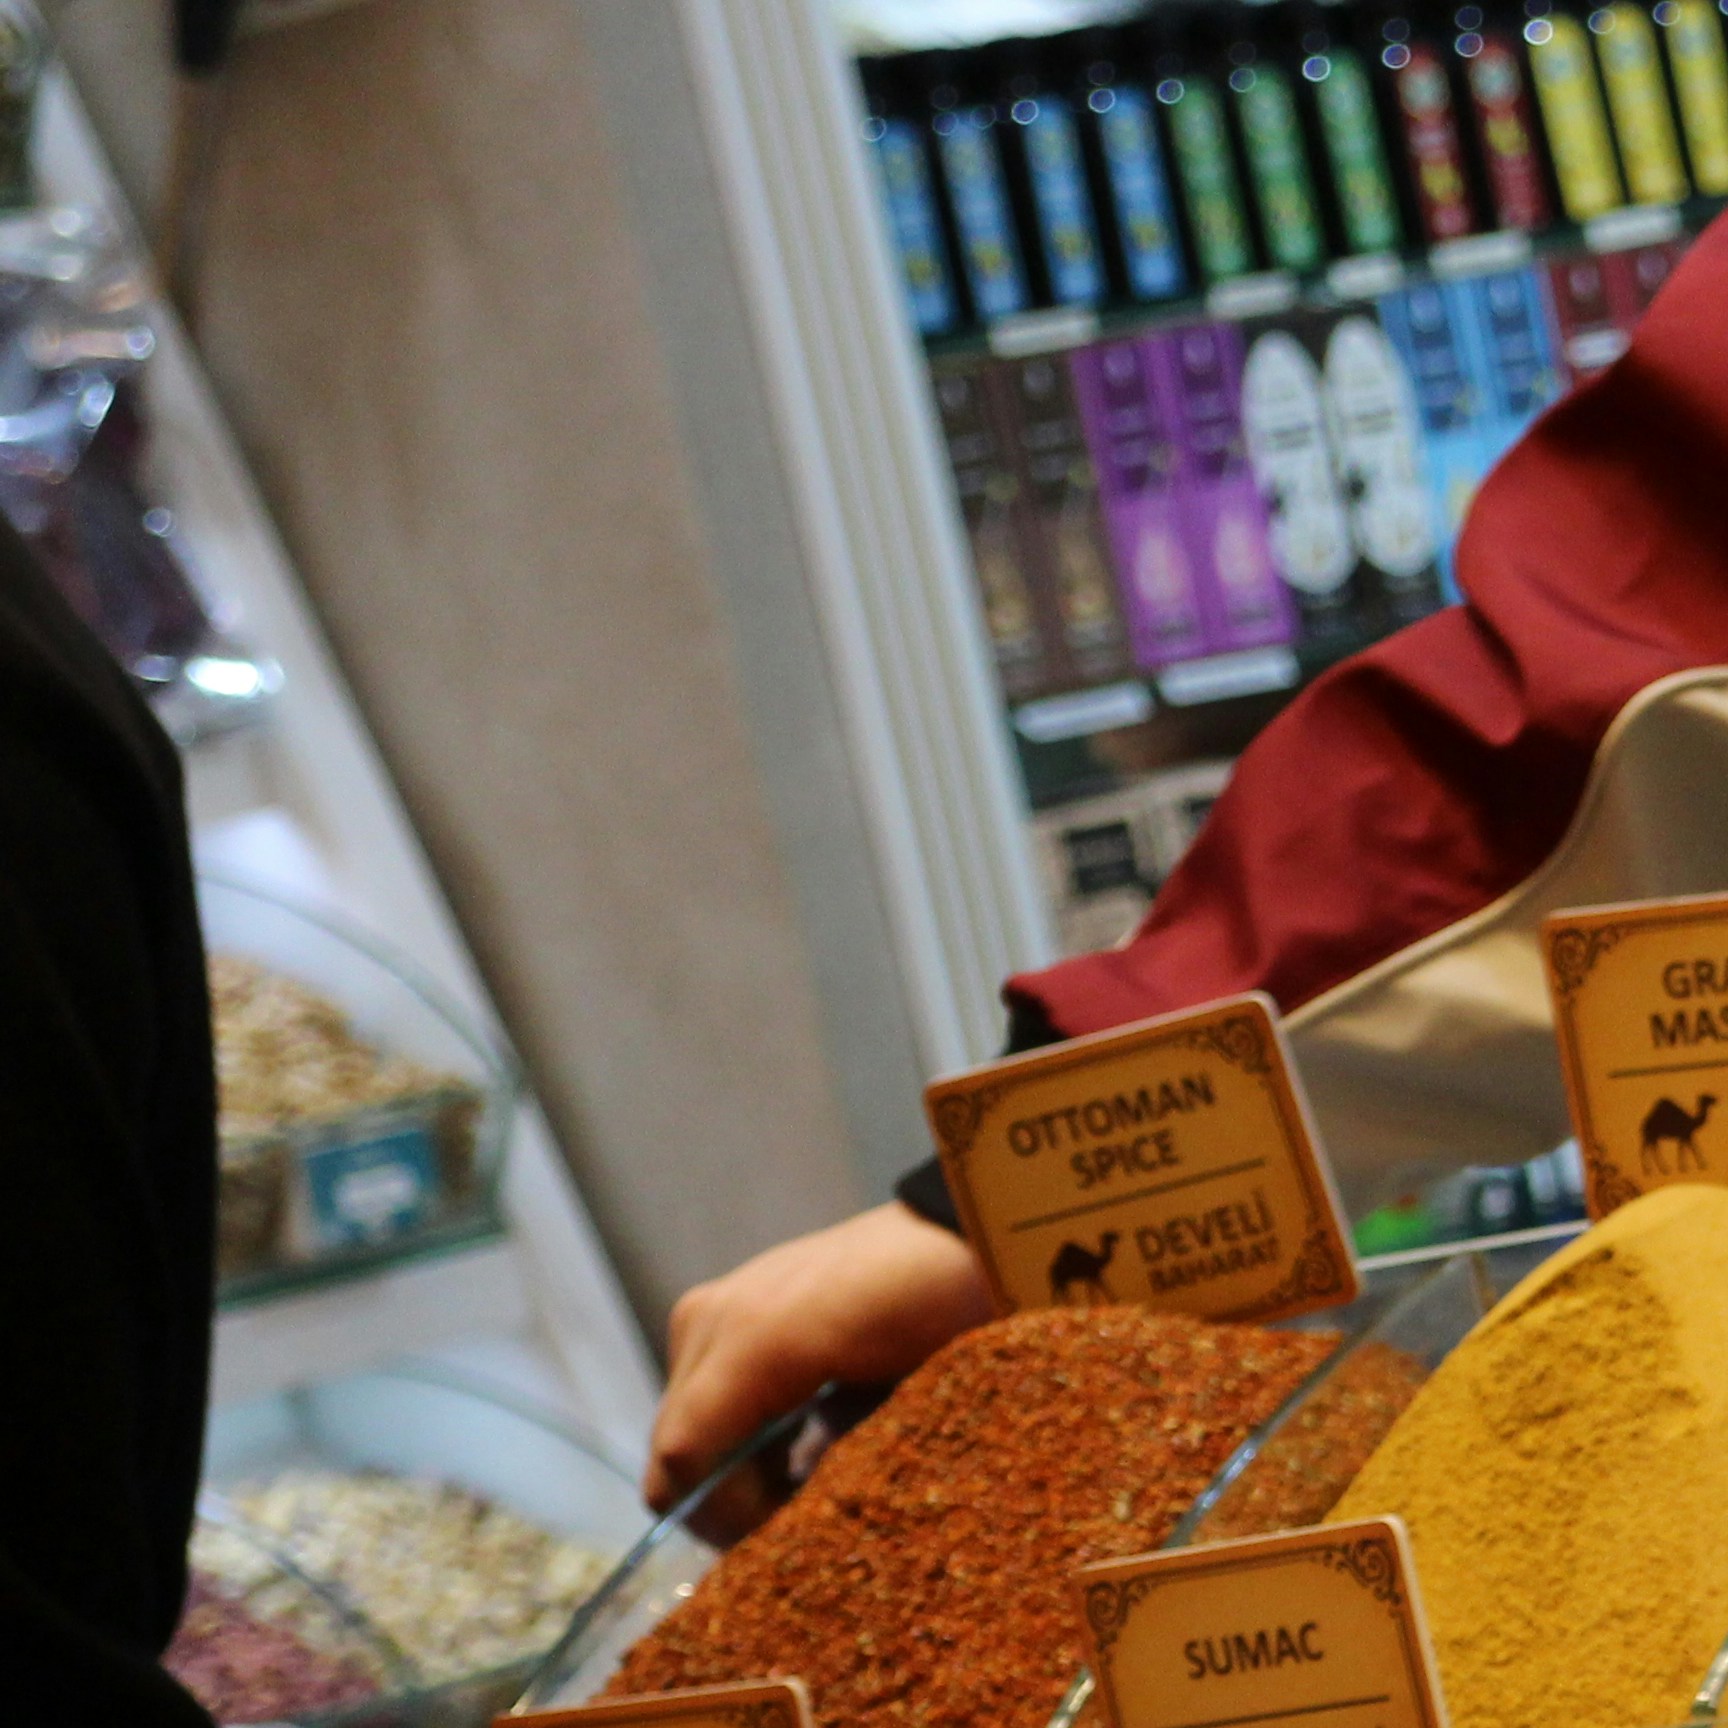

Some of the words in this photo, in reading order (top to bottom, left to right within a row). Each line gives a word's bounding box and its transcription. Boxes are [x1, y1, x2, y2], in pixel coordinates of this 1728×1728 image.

[1006, 1071, 1216, 1158] OTTOMAN
[1070, 1128, 1184, 1190] SPICE
[1184, 1621, 1325, 1680] SUMAC
